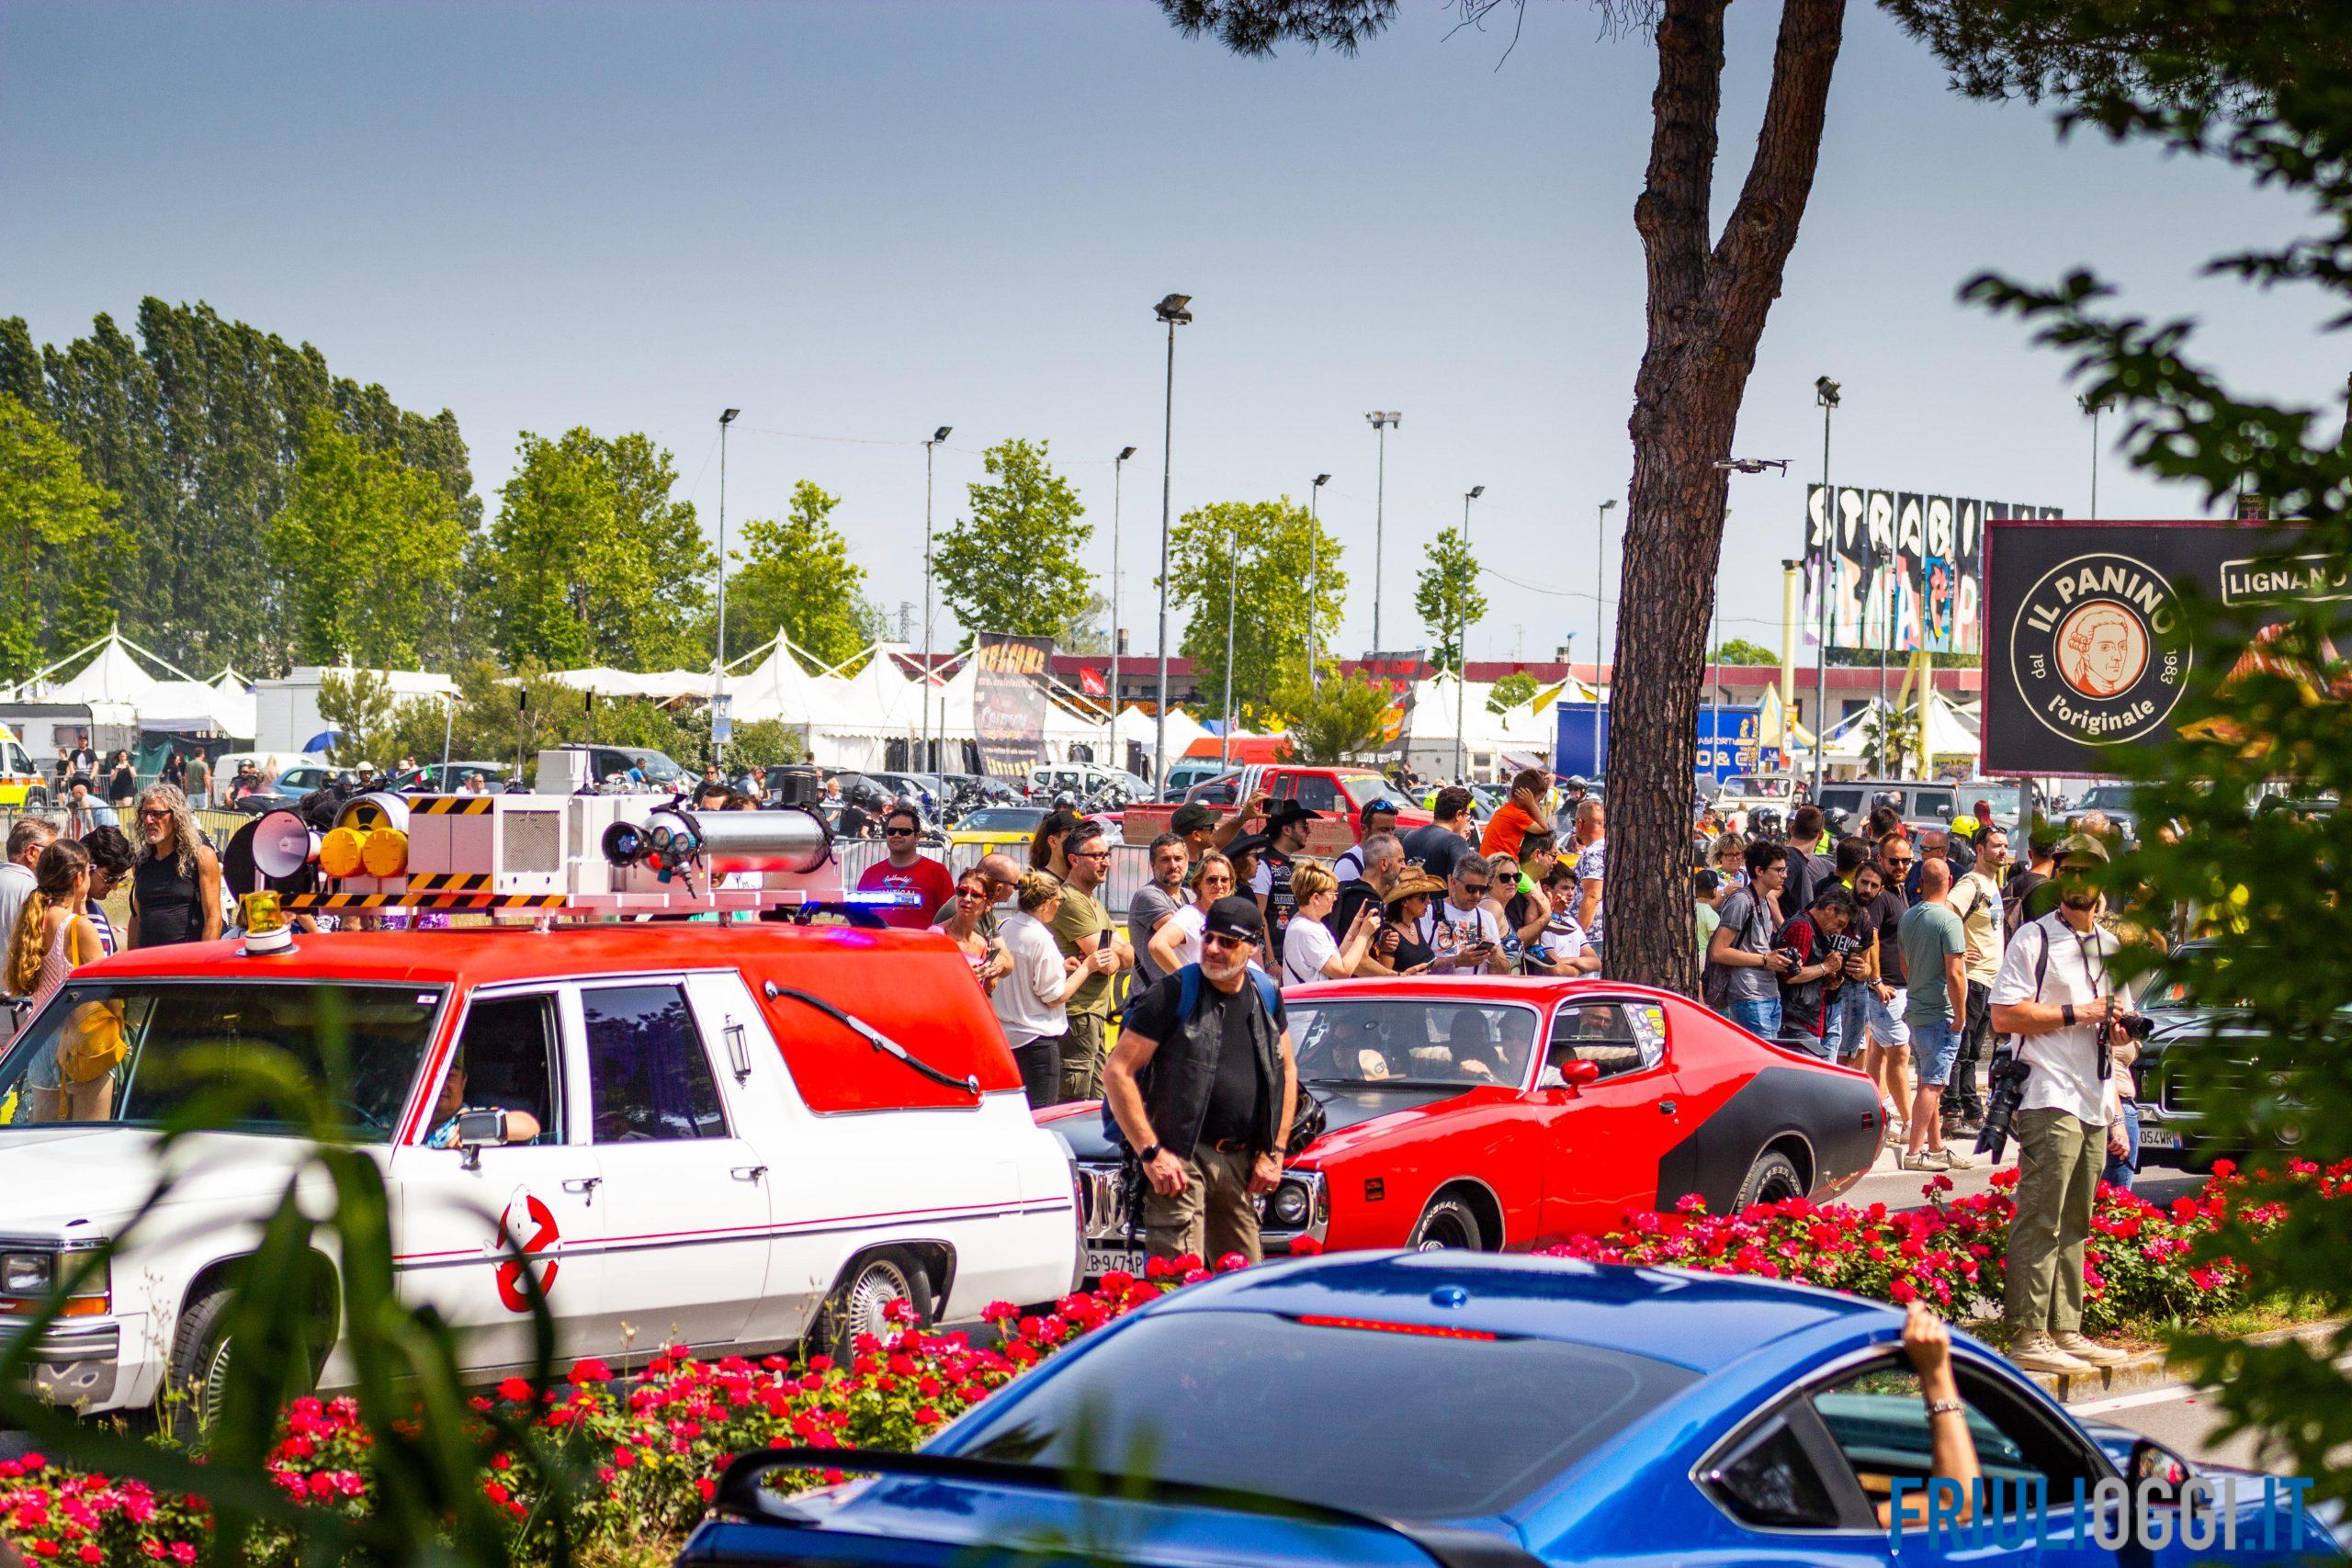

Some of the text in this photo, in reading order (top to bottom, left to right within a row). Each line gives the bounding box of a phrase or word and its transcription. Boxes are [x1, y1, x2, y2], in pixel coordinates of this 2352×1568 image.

[2028, 566, 2176, 635] IL PANINO
[2030, 654, 2046, 679] dal
[2161, 649, 2177, 684] 1983
[2048, 694, 2154, 736] l'originale
